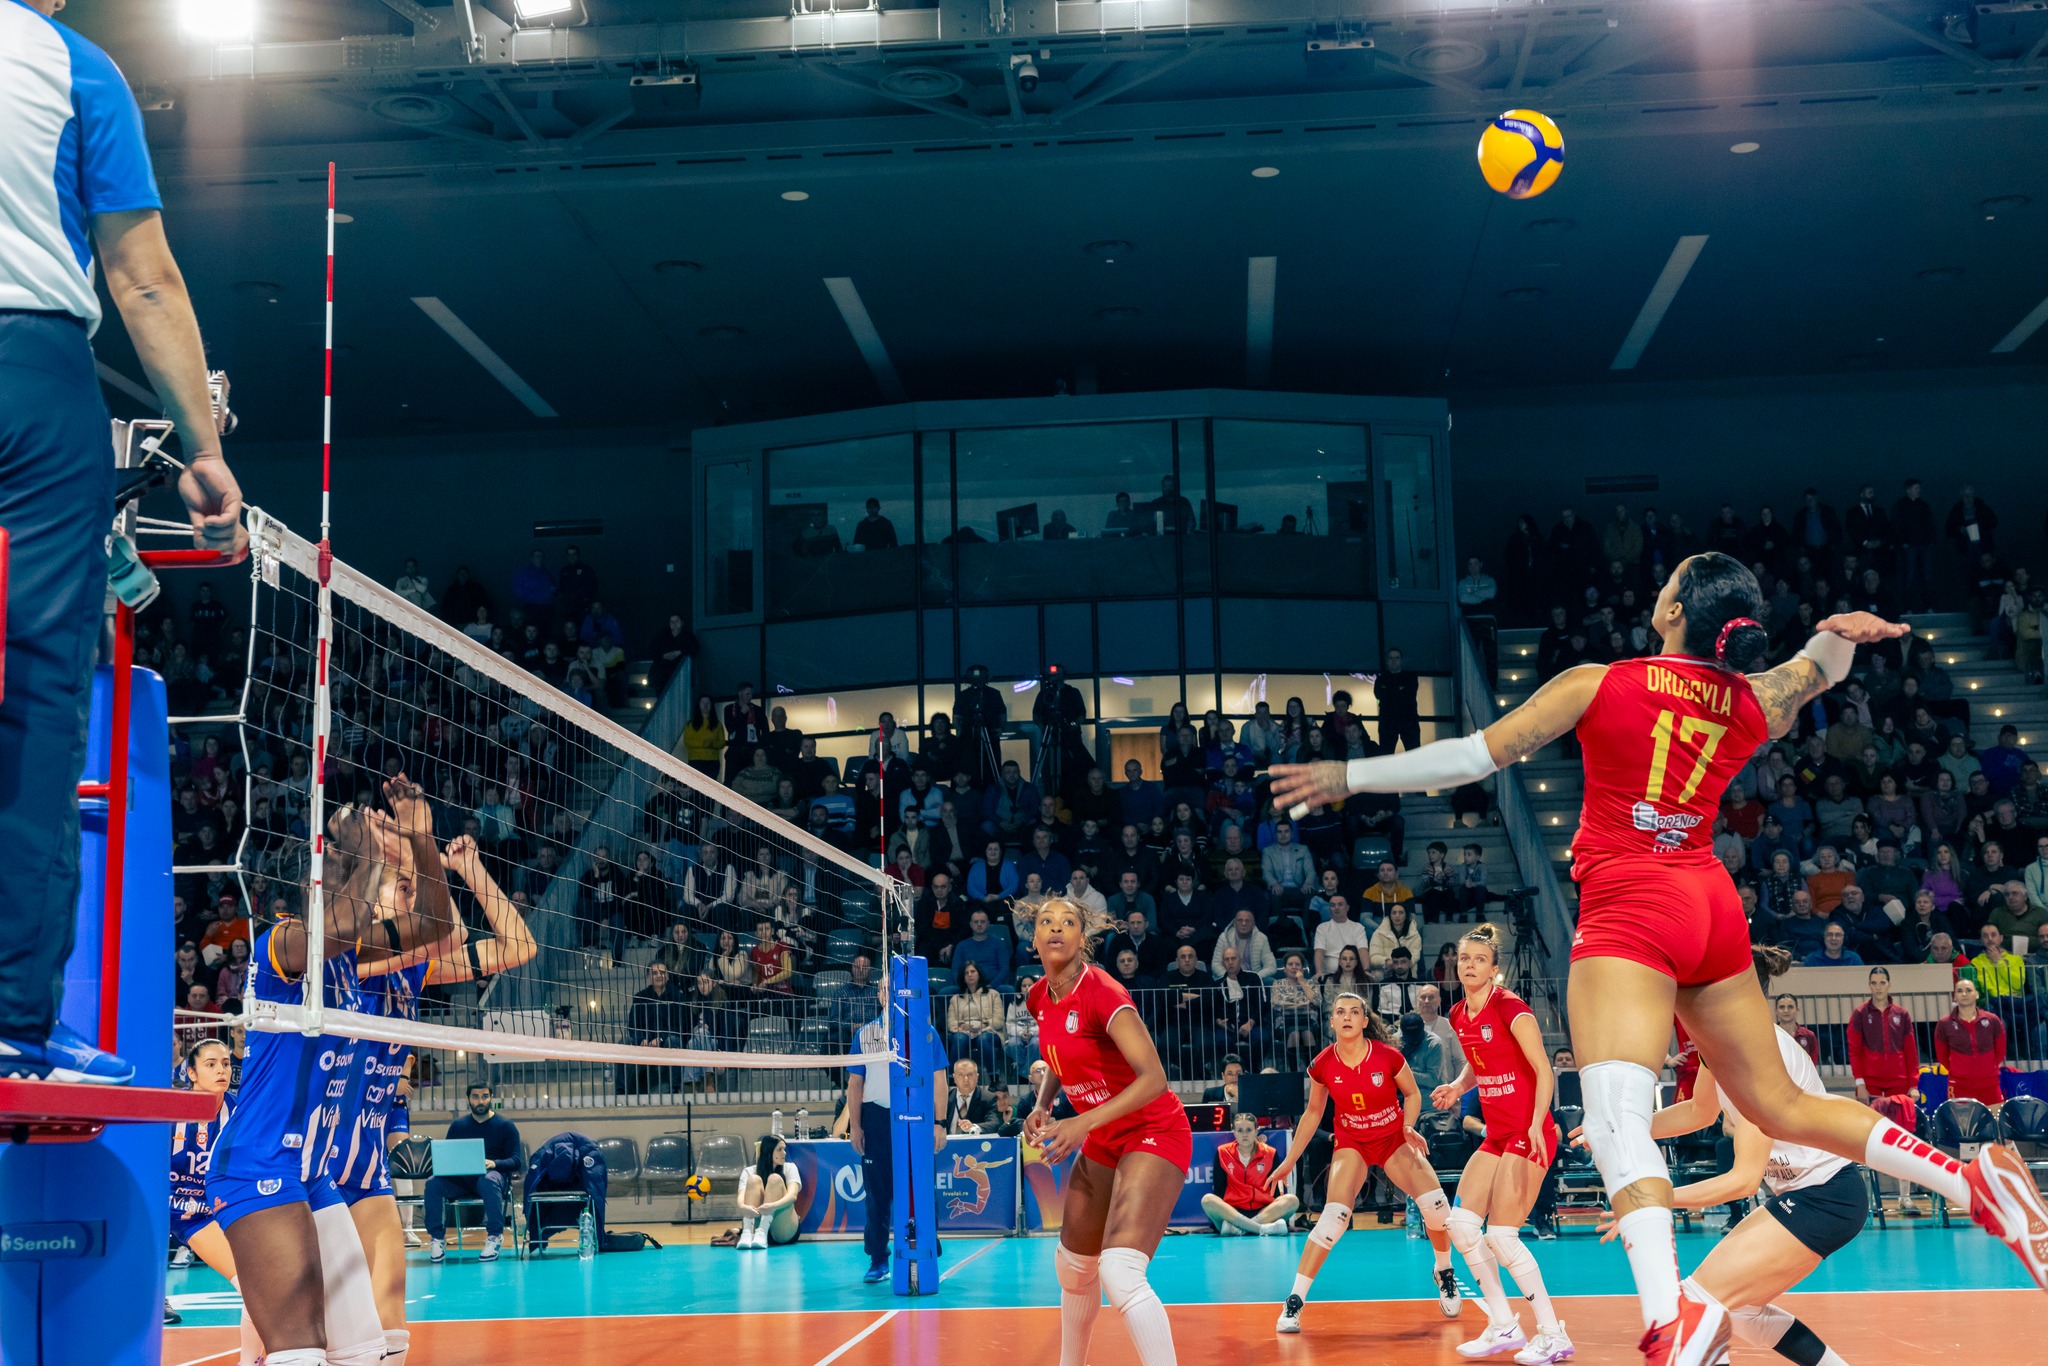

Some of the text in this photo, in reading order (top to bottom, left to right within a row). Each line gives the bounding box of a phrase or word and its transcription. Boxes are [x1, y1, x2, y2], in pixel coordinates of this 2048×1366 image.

[1645, 710, 1728, 804] 17
[1047, 1044, 1063, 1077] 11
[1352, 1093, 1366, 1111] 9
[1213, 1107, 1224, 1125] 3
[187, 1151, 208, 1175] 12
[13, 1235, 76, 1251] Senoh
